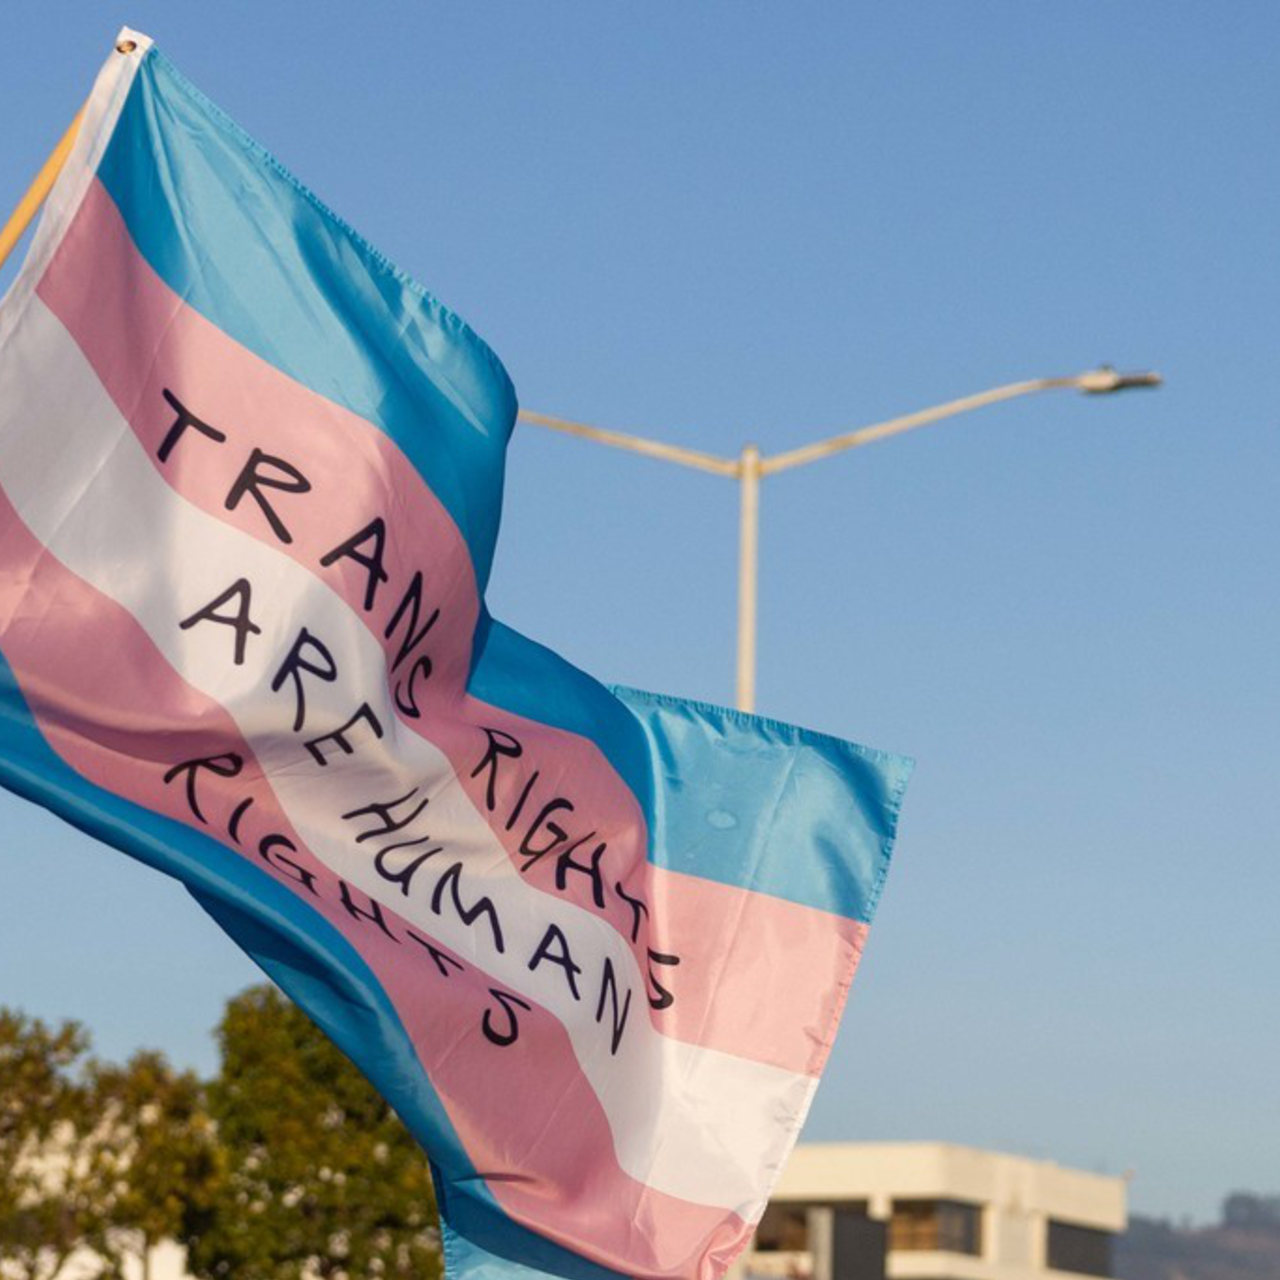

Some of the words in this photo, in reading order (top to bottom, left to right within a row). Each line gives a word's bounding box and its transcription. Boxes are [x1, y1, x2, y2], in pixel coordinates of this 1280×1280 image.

[157, 387, 440, 718] TRANS
[471, 726, 680, 1010] RIGHTS
[163, 752, 531, 1047] RIGHTS
[179, 578, 383, 767] ARE
[341, 786, 632, 1056] HUMAN
